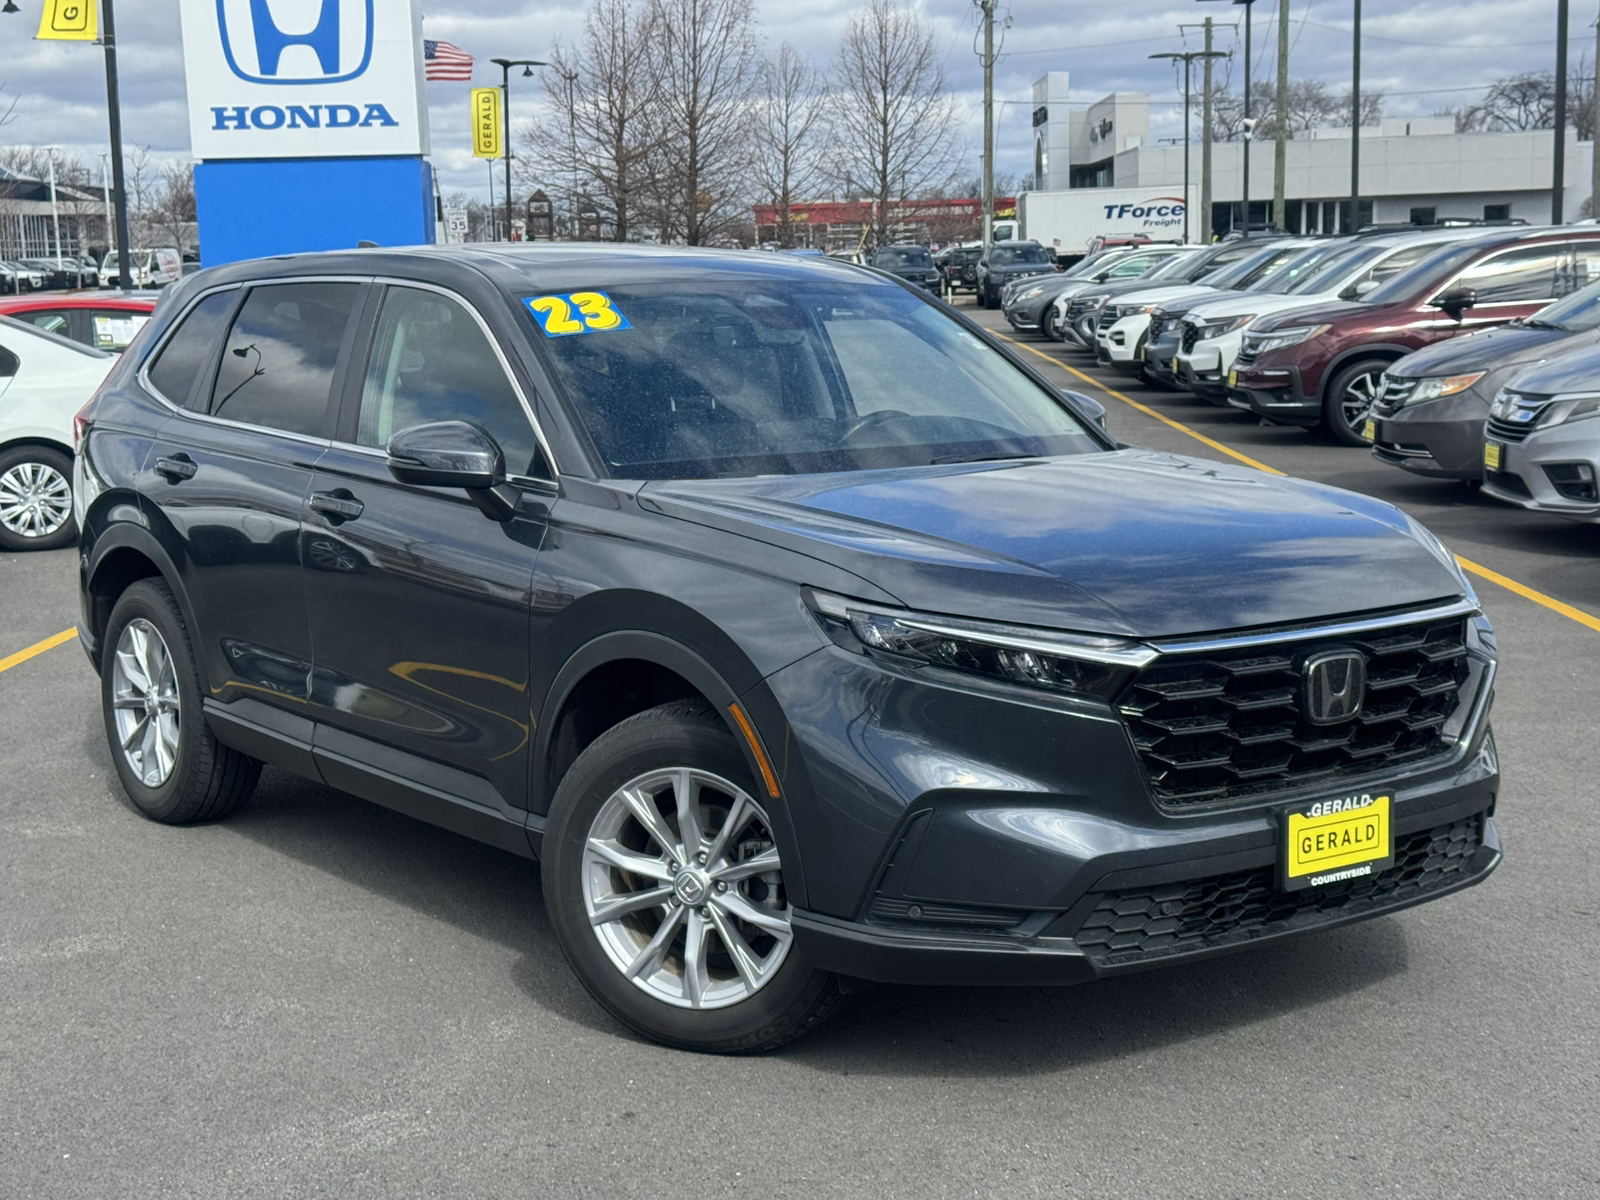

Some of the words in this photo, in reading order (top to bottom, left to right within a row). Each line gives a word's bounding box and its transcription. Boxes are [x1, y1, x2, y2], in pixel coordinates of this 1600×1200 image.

[210, 103, 399, 130] HONDA
[482, 96, 492, 148] GERALD
[1103, 203, 1186, 219] TForce
[1143, 218, 1182, 227] Freight
[451, 221, 466, 231] 35
[530, 292, 622, 334] 23
[1302, 824, 1375, 854] GERALD
[1311, 865, 1371, 886] COUNTRYSIDE
